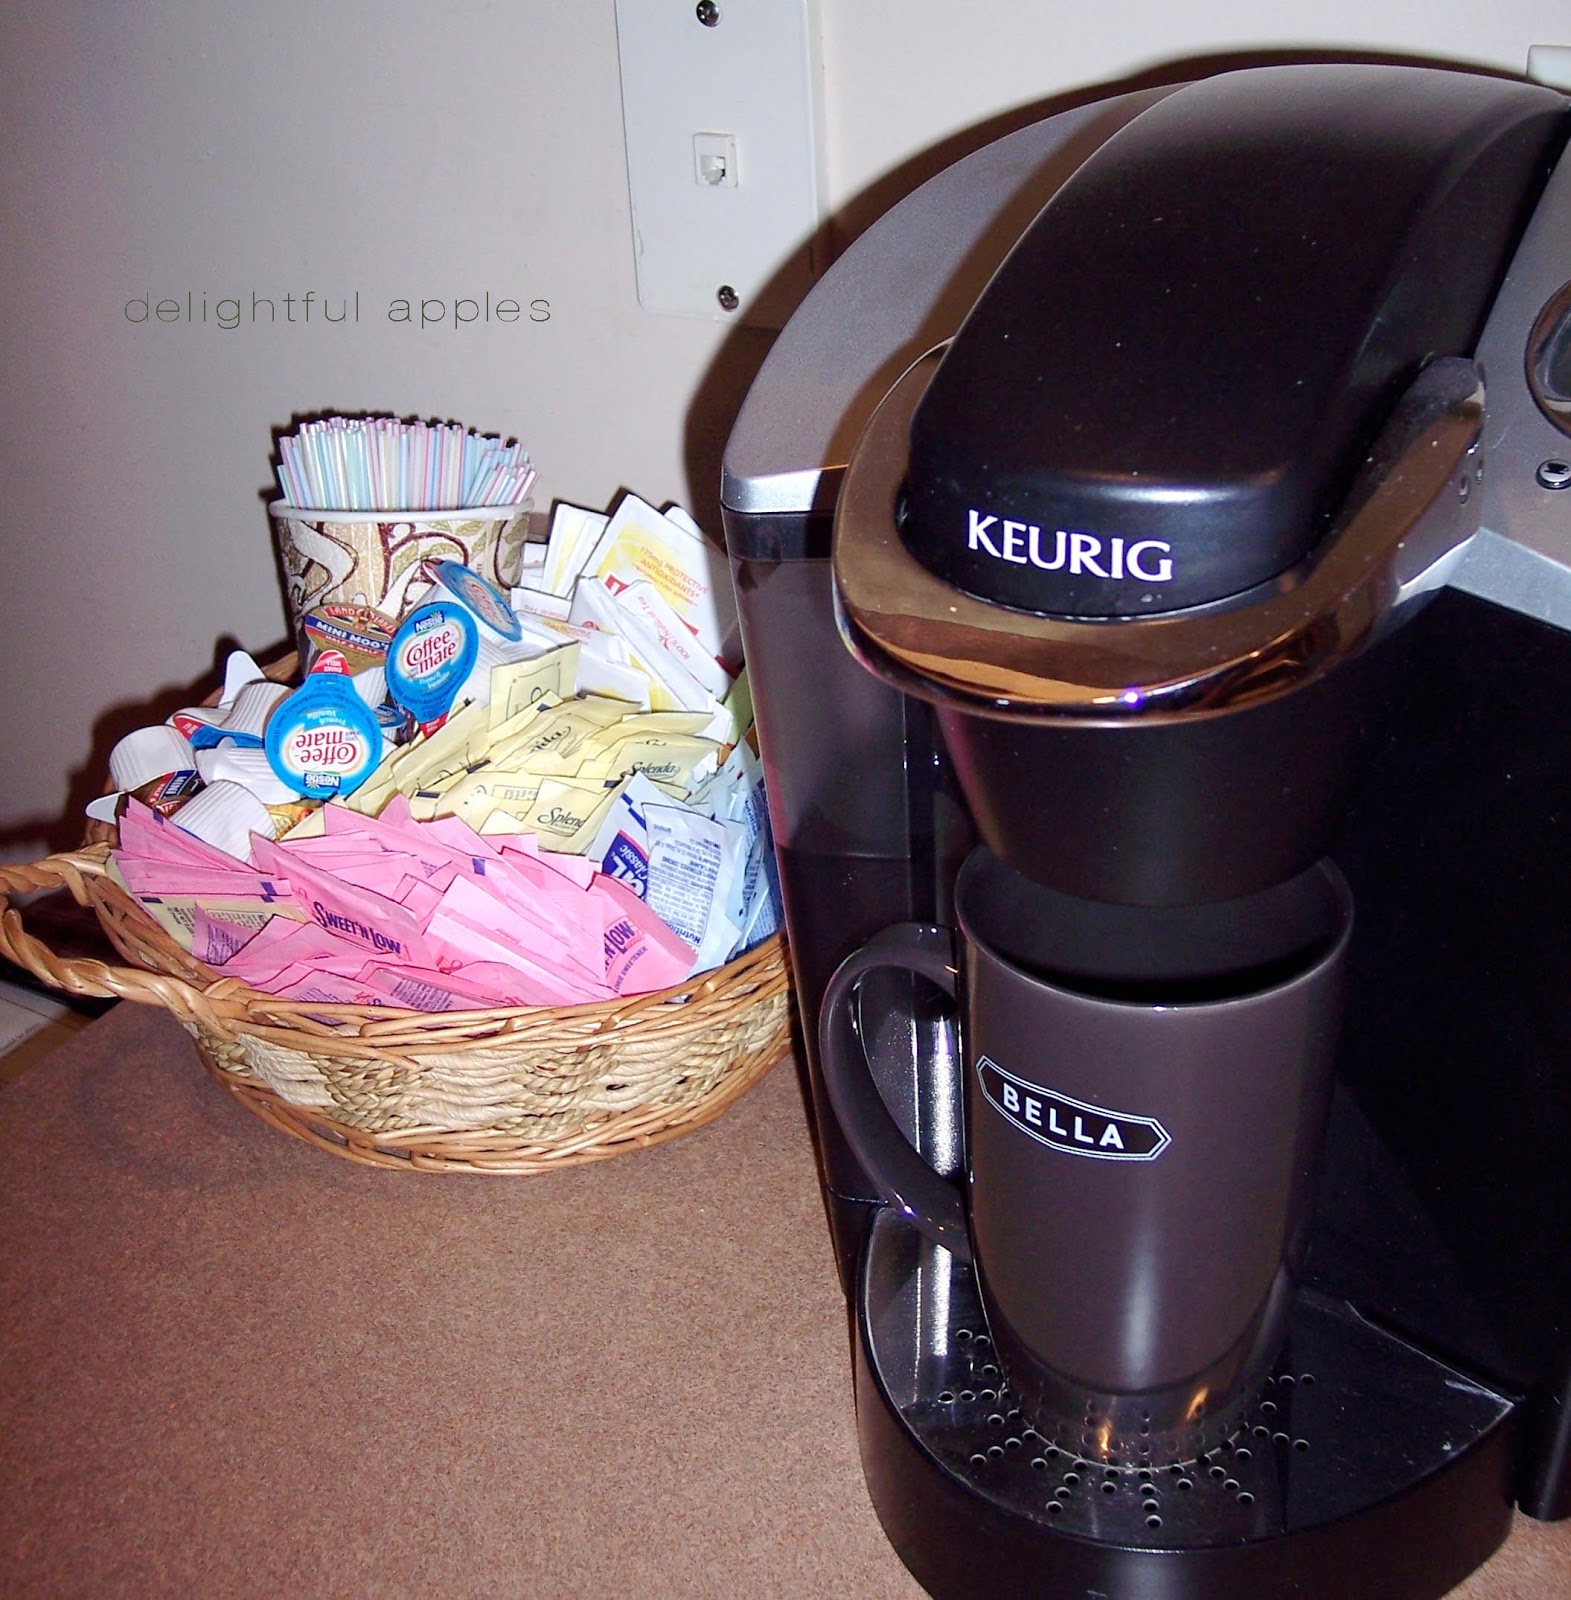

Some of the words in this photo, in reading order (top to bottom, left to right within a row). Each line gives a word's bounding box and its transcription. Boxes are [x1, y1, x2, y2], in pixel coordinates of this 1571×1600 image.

[967, 508, 1174, 582] KEURIG
[330, 606, 355, 617] LAND
[316, 621, 347, 638] MINI
[419, 642, 456, 674] mate
[306, 709, 337, 720] Vanilla
[296, 730, 344, 749] mate
[537, 806, 586, 831] Splend
[618, 843, 648, 880] Classic
[370, 926, 401, 955] LOW
[610, 919, 637, 954] LOW
[665, 923, 702, 945] Nutritio
[621, 945, 648, 977] SWEETENER
[1003, 1082, 1125, 1150] BELLA
